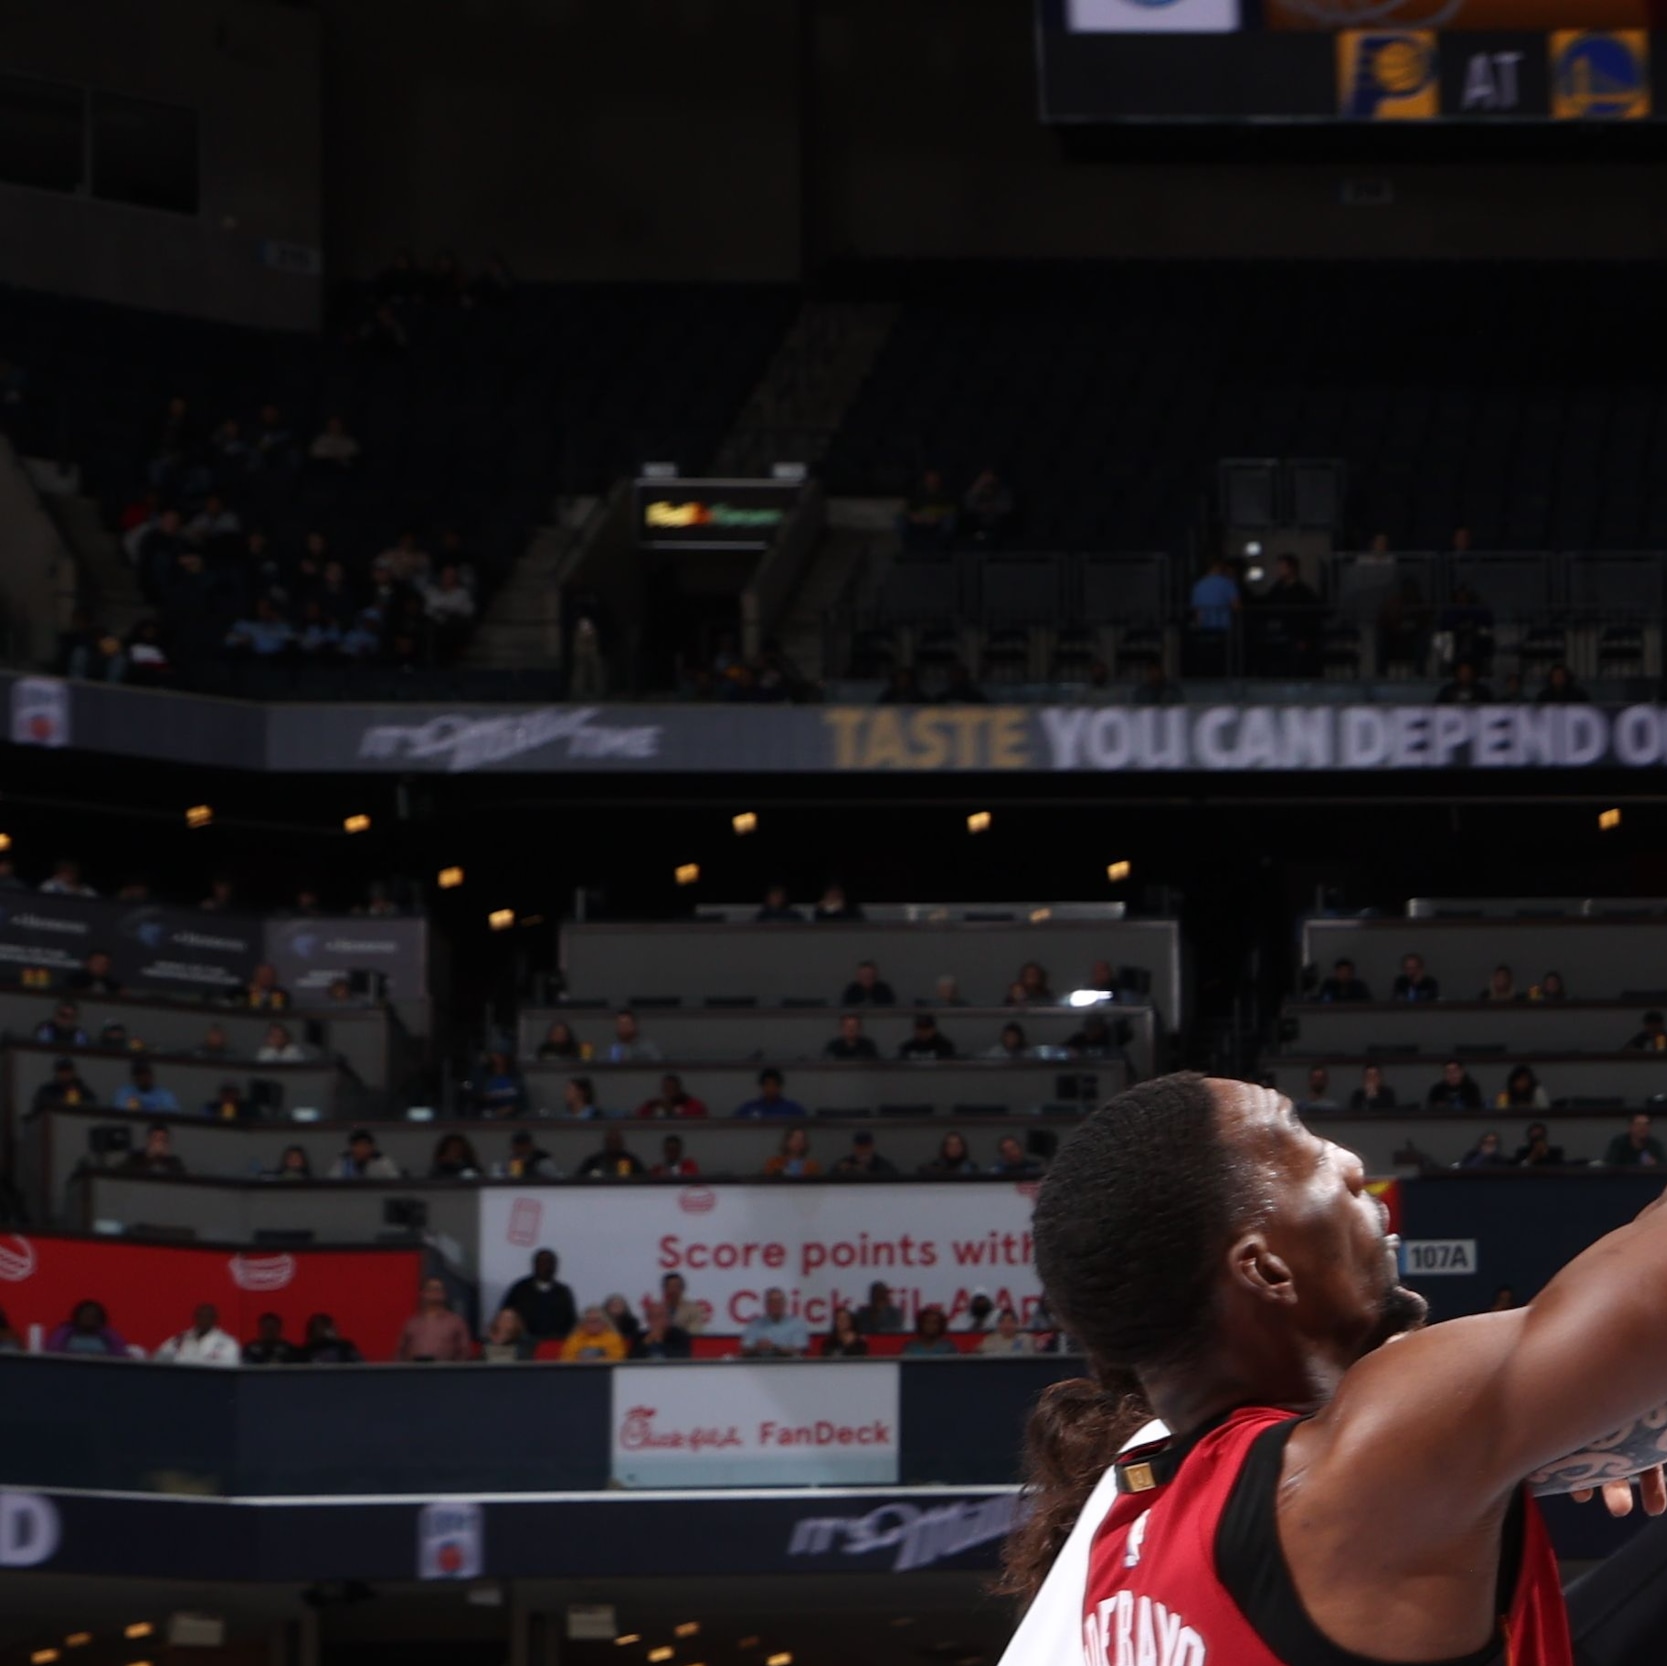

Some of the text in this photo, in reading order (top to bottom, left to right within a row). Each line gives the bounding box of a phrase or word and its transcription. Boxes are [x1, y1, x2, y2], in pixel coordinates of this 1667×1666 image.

[1460, 50, 1523, 110] AT
[822, 704, 1029, 770] TASTE
[1044, 704, 1194, 769] YOU
[1200, 703, 1337, 769] CAN
[1341, 703, 1610, 769] DEPEND
[658, 1235, 786, 1269] Score
[802, 1232, 937, 1276] points
[1411, 1245, 1468, 1269] 107A
[758, 1420, 891, 1446] FanDeck
